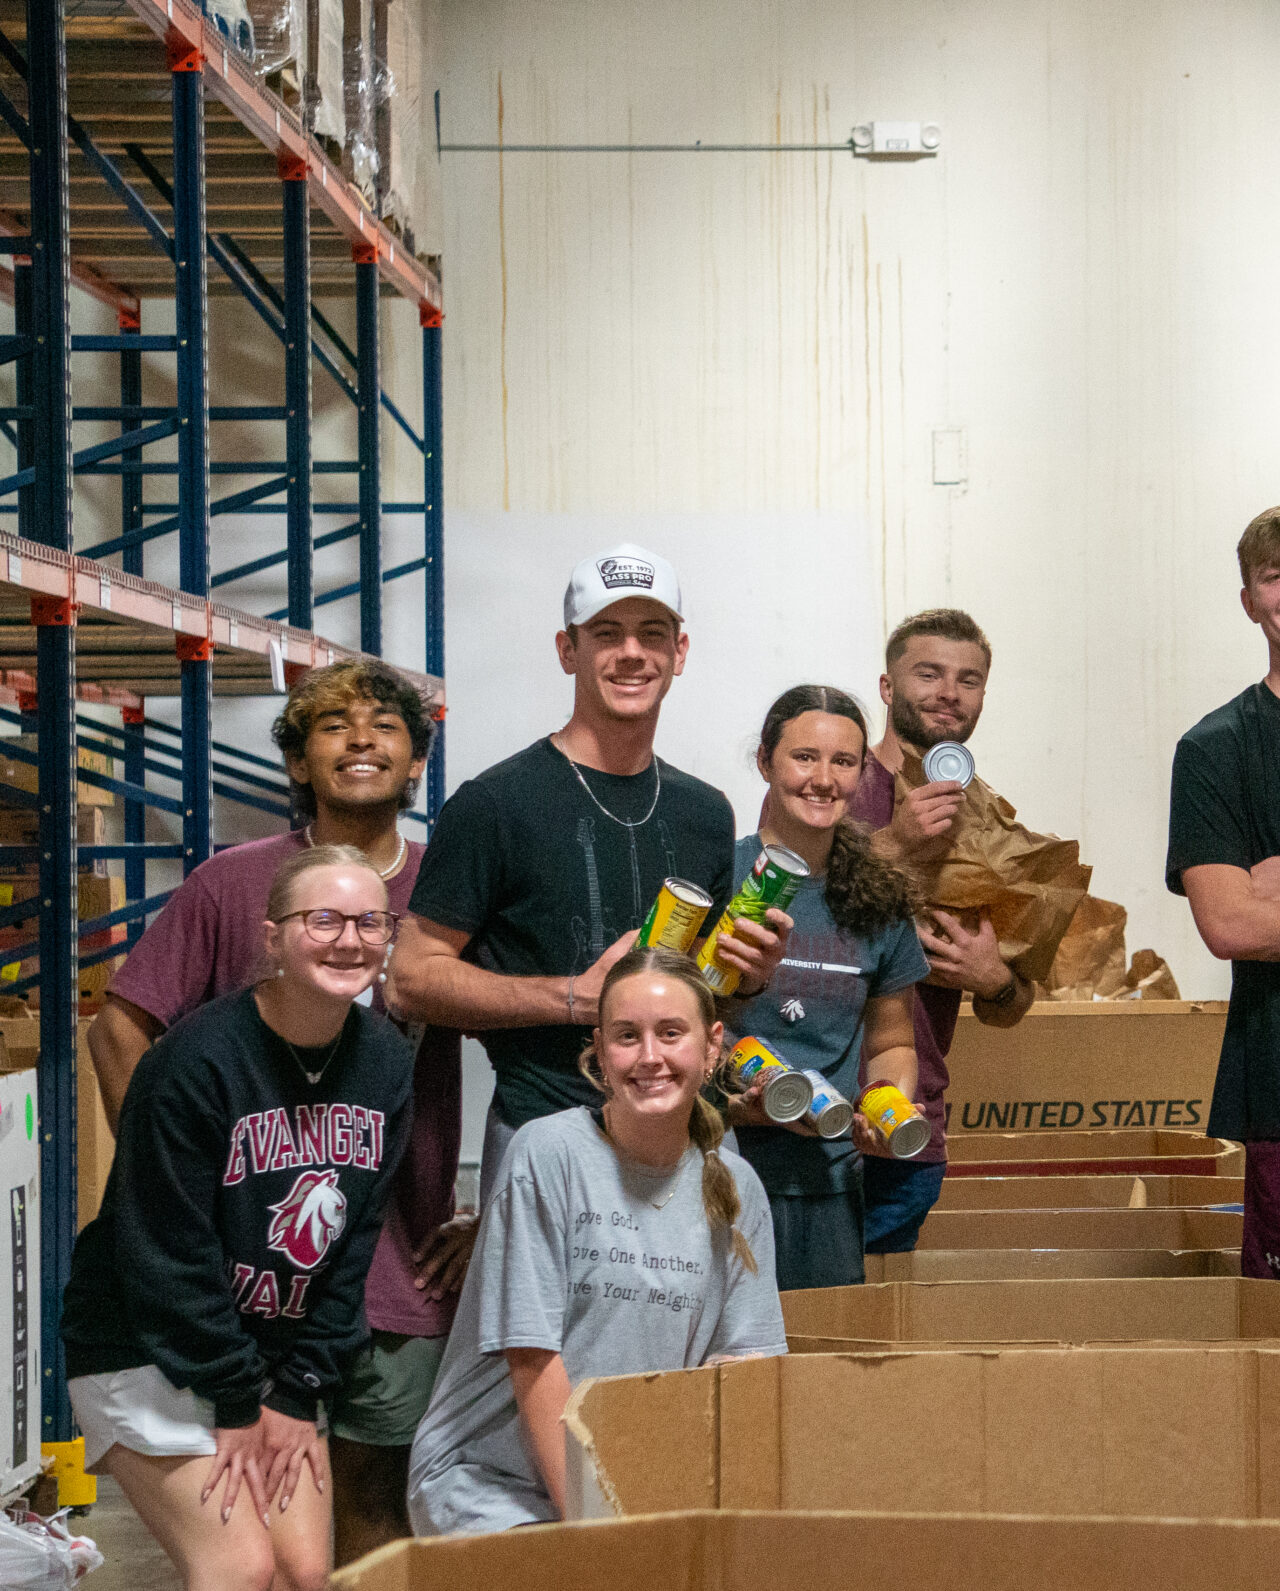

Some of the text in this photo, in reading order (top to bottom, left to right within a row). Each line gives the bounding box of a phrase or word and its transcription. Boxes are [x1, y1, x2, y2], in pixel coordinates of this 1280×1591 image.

[604, 573, 652, 582] BASS PRO
[636, 565, 652, 574] 1972
[780, 958, 820, 970] NIVERSITY
[961, 1101, 1085, 1129] UNITED
[1089, 1099, 1202, 1127] STATES
[575, 1211, 640, 1231] ove God.
[609, 1247, 636, 1265] One
[642, 1253, 704, 1276] Another.
[604, 1282, 640, 1302] Your
